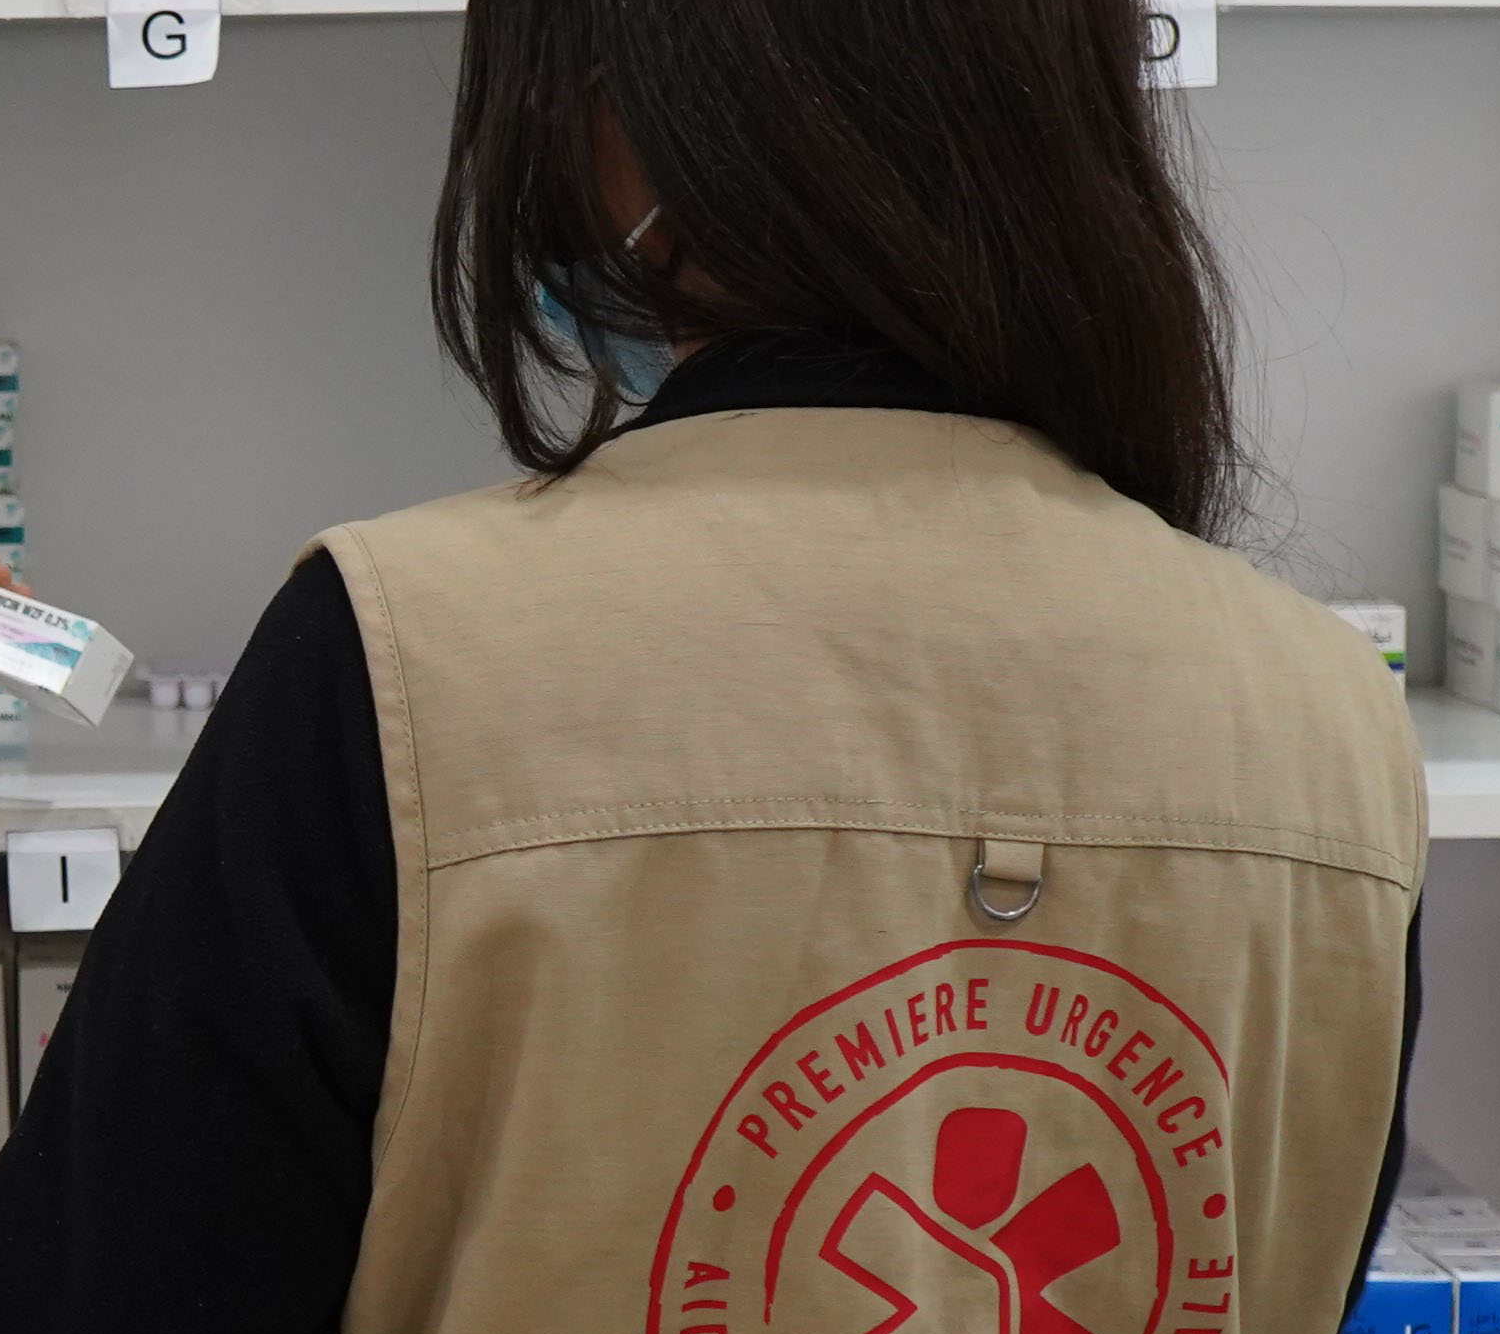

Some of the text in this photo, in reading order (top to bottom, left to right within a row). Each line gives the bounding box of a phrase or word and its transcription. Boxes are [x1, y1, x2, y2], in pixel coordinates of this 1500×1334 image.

[141, 11, 188, 60] G
[736, 978, 1225, 1170] PREMIERE URGENCE
